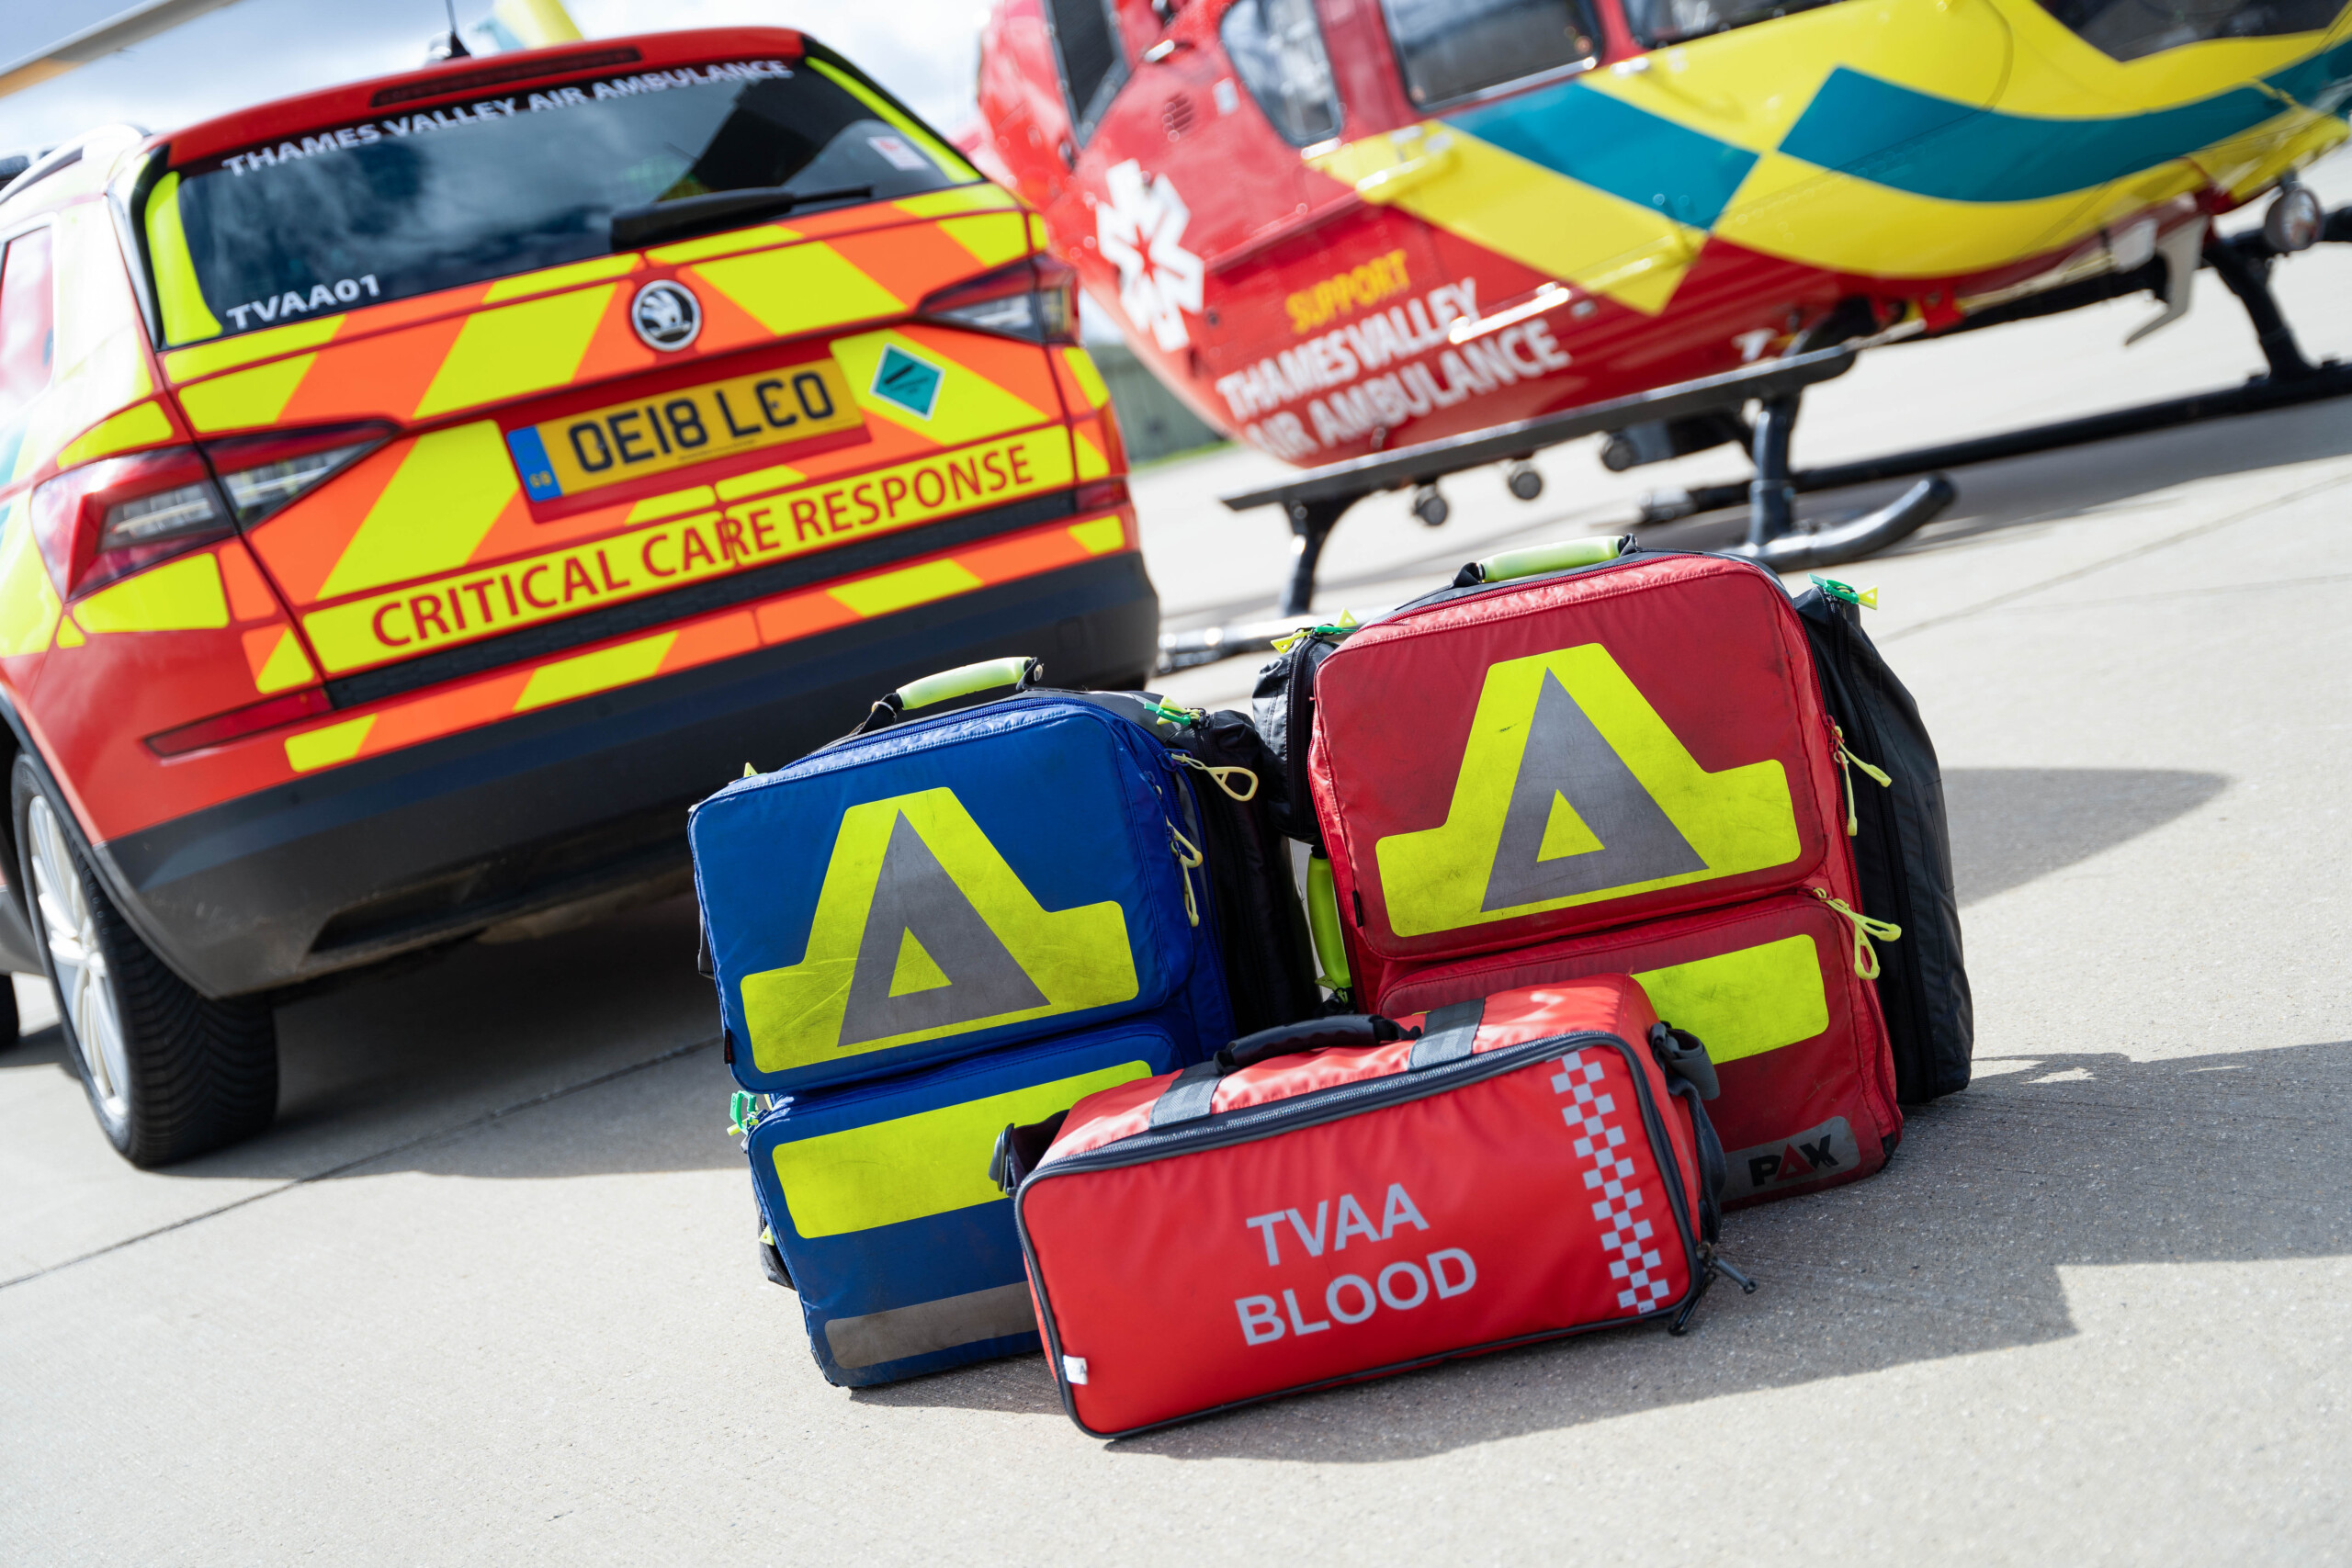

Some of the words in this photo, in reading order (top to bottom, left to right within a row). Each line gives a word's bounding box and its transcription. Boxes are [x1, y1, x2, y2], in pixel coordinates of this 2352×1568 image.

[221, 124, 380, 176] THAMES
[383, 97, 518, 139] VALLEY
[529, 86, 586, 113] AIR
[593, 60, 795, 102] AMBULANCE
[227, 274, 380, 331] TVAA01
[1287, 249, 1408, 334] SUPPORT
[1216, 329, 1359, 421] THAMES
[1348, 277, 1481, 371] VALLEY
[1247, 410, 1319, 459] AIR
[1307, 319, 1572, 446] AMBULANCE
[568, 399, 708, 474] OE18
[714, 371, 834, 438] LCO
[372, 548, 629, 648] CRITICAL
[642, 506, 782, 579] CARE
[796, 446, 1033, 541] RESPONSE
[1748, 1134, 1839, 1187] PAX
[1246, 1182, 1430, 1267] TVAA
[1235, 1247, 1476, 1347] BLOOD
